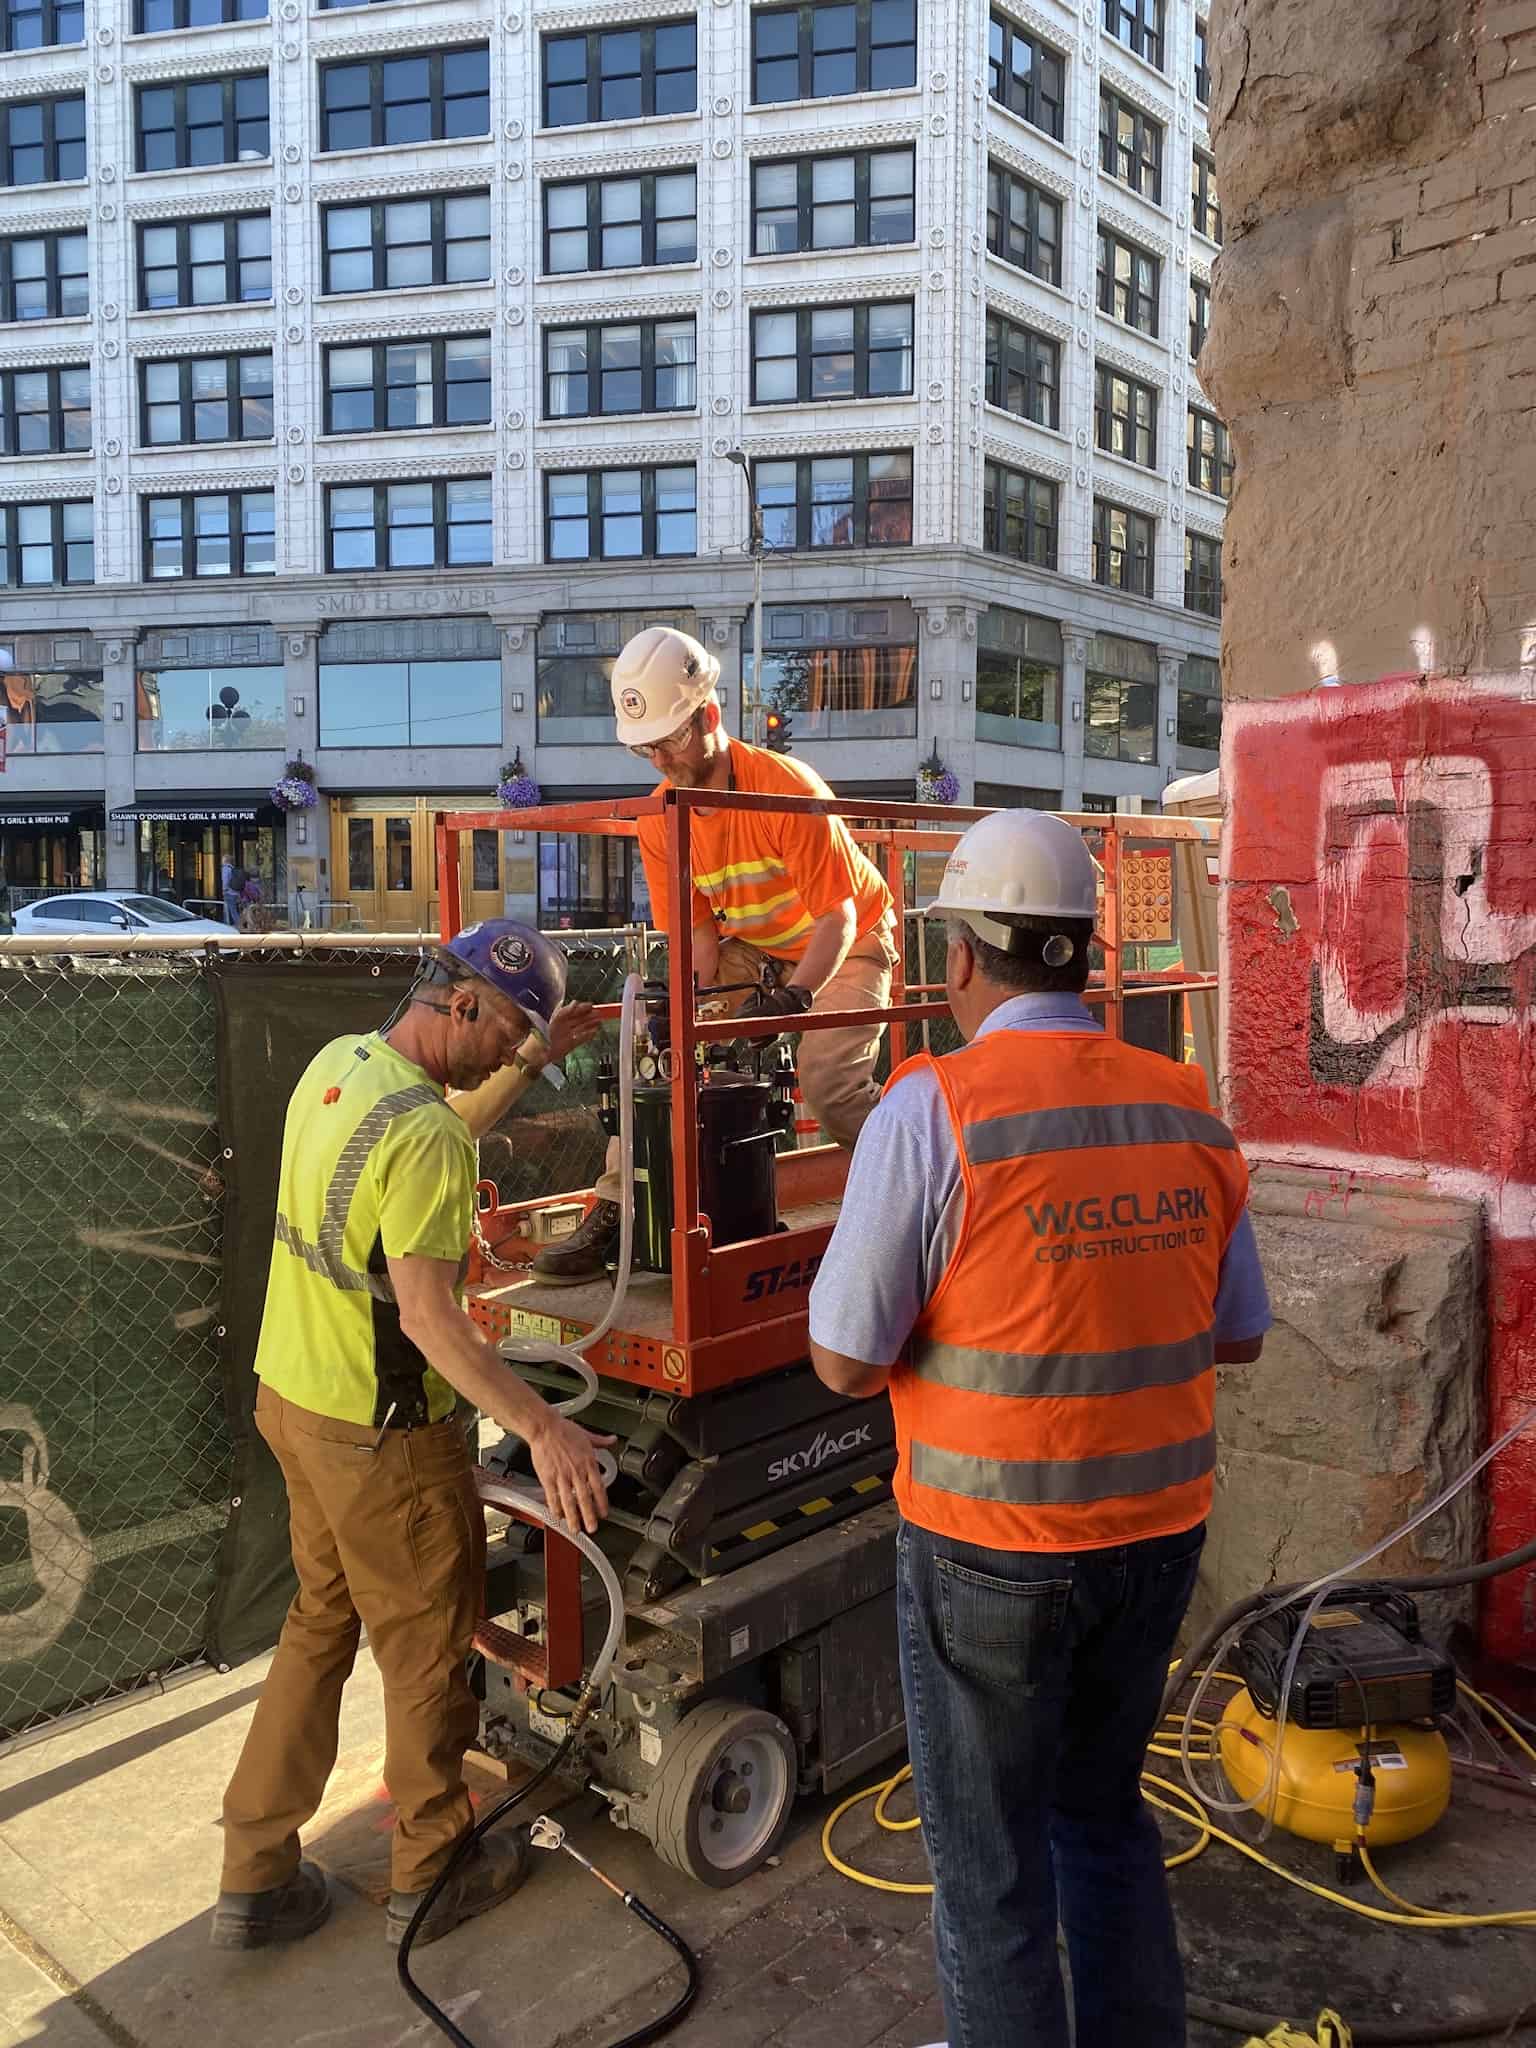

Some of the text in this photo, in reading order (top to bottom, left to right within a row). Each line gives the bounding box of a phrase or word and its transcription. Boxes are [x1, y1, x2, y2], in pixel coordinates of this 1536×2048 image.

[408, 588, 496, 609] TOWER
[6, 817, 27, 825] GRILL
[29, 816, 34, 824] &
[35, 816, 54, 824] IRISH
[54, 815, 70, 823] PUB
[110, 812, 256, 821] SHAWN O'DONNELL'S GRILL & IRISH PUB
[1034, 1228, 1187, 1264] CONSTRUCTION
[767, 1423, 872, 1482] SKYJACK
